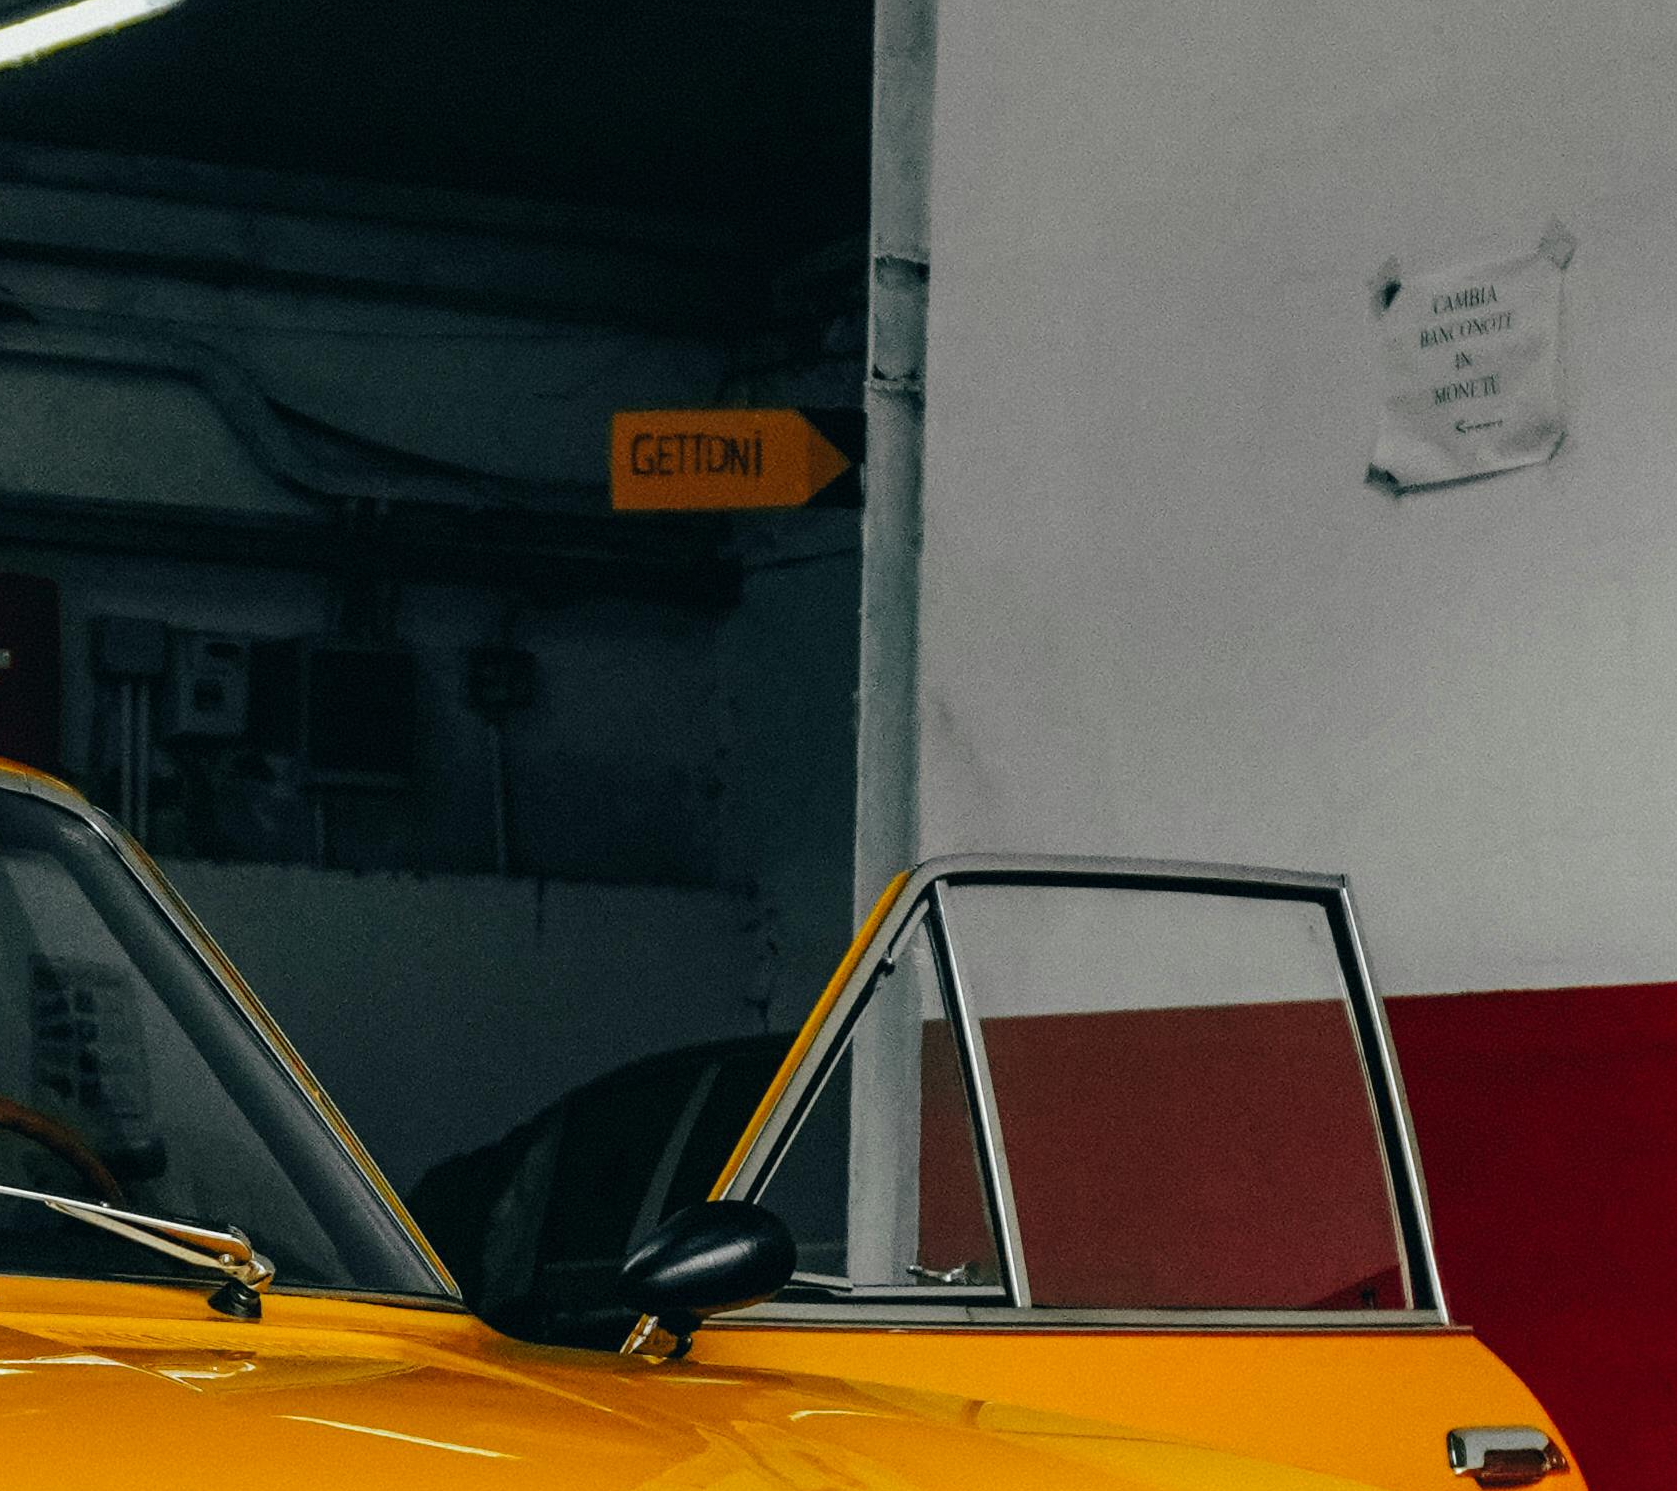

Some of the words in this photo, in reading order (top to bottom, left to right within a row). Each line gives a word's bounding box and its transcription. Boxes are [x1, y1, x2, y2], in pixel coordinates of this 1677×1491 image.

[1431, 284, 1498, 315] CAMBIA
[1454, 351, 1473, 370] IN
[629, 429, 763, 478] GETTONI
